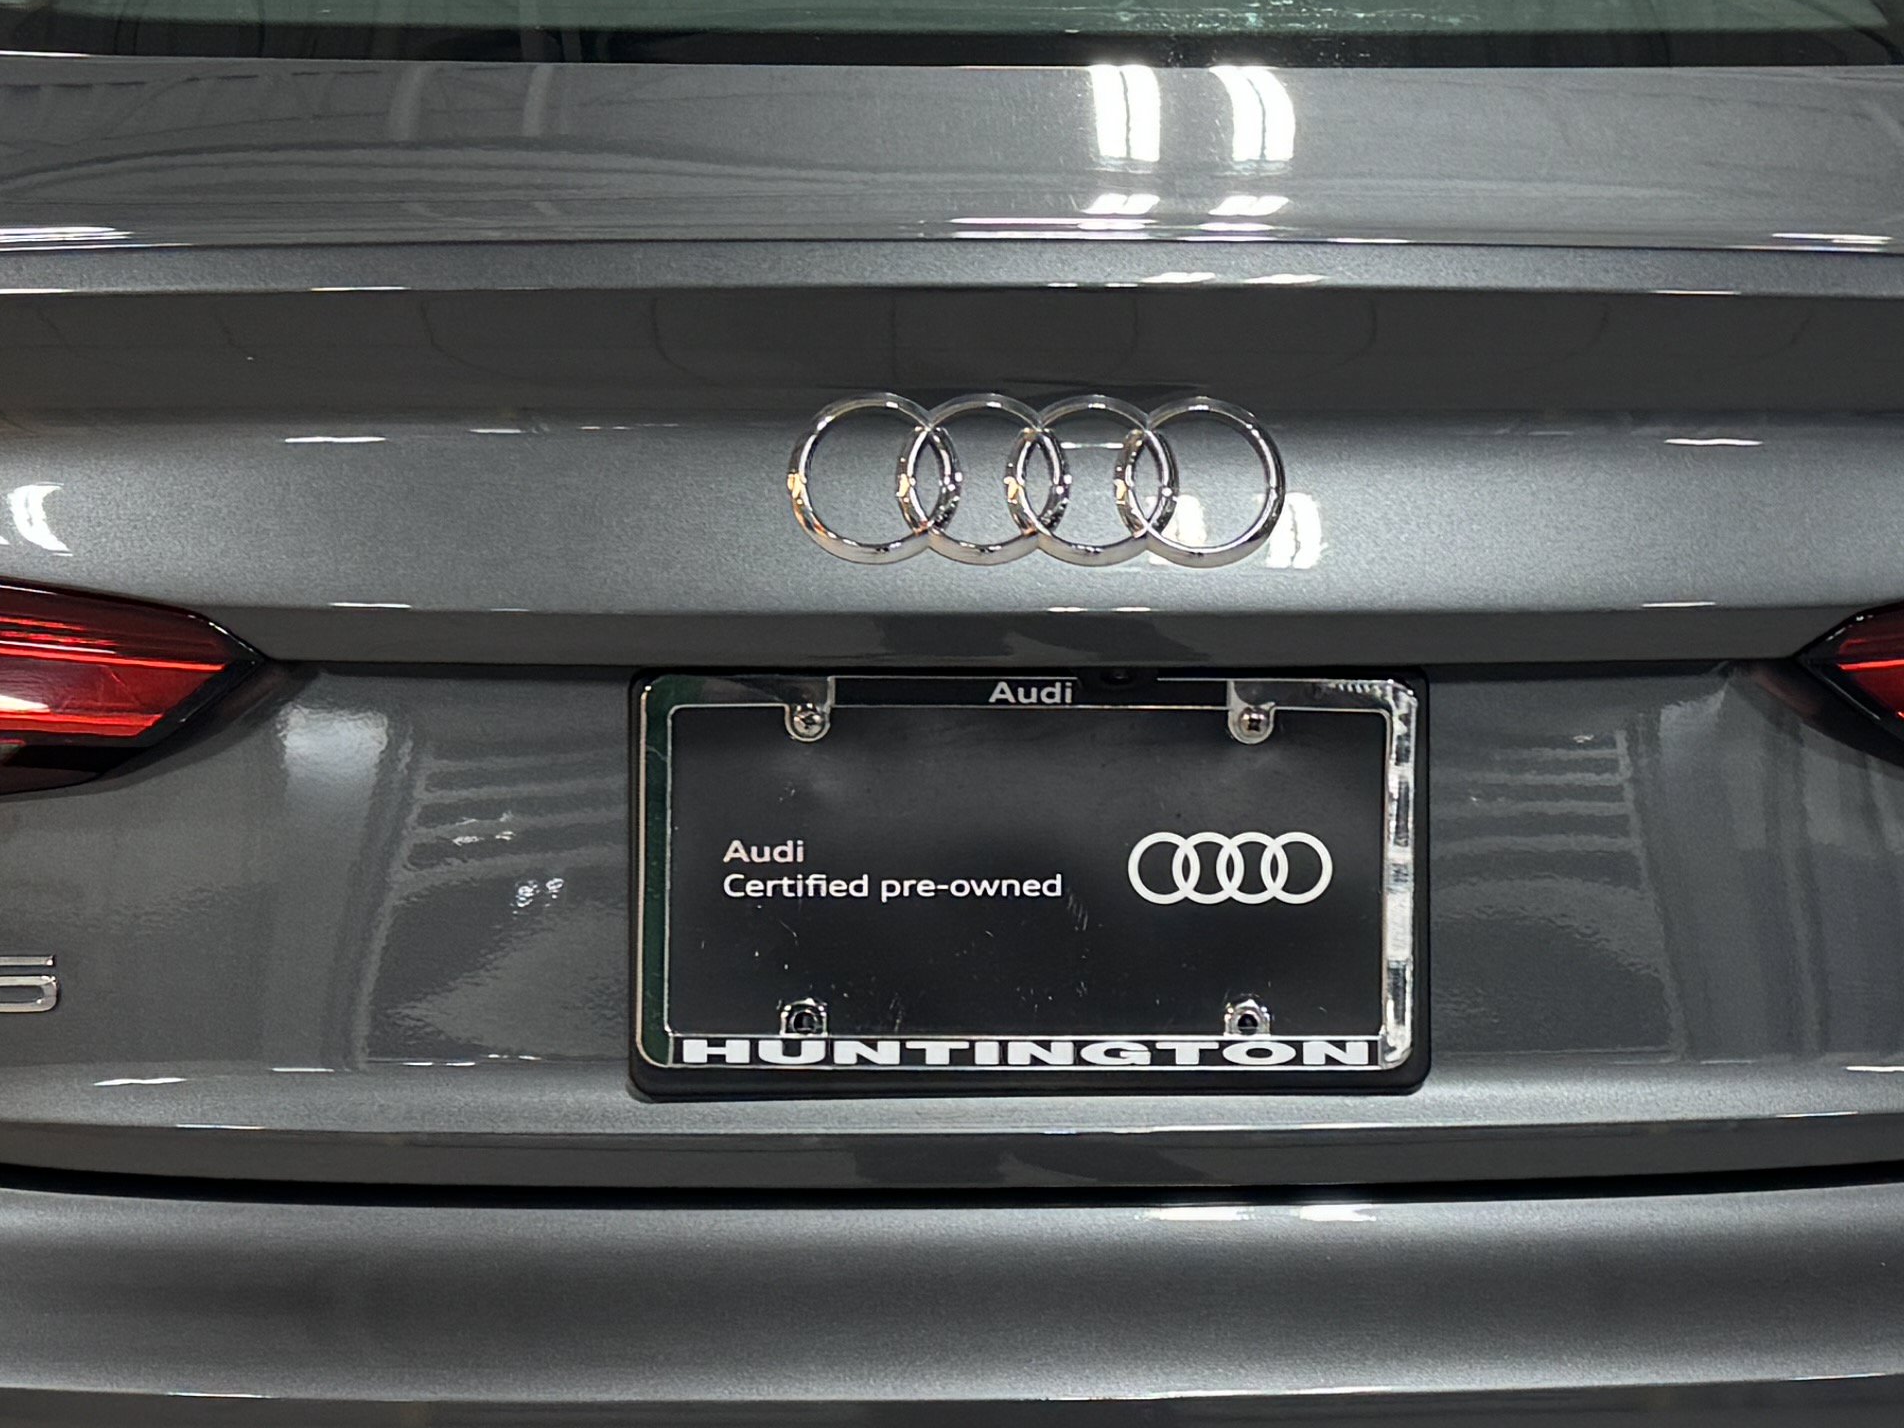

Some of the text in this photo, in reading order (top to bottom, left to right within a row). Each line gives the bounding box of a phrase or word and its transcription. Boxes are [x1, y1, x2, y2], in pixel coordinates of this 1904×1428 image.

[988, 681, 1073, 705] Audi
[723, 839, 805, 865] Audi
[723, 873, 1063, 903] Certified pre-owned
[681, 1038, 1369, 1066] HUNTINGTON
